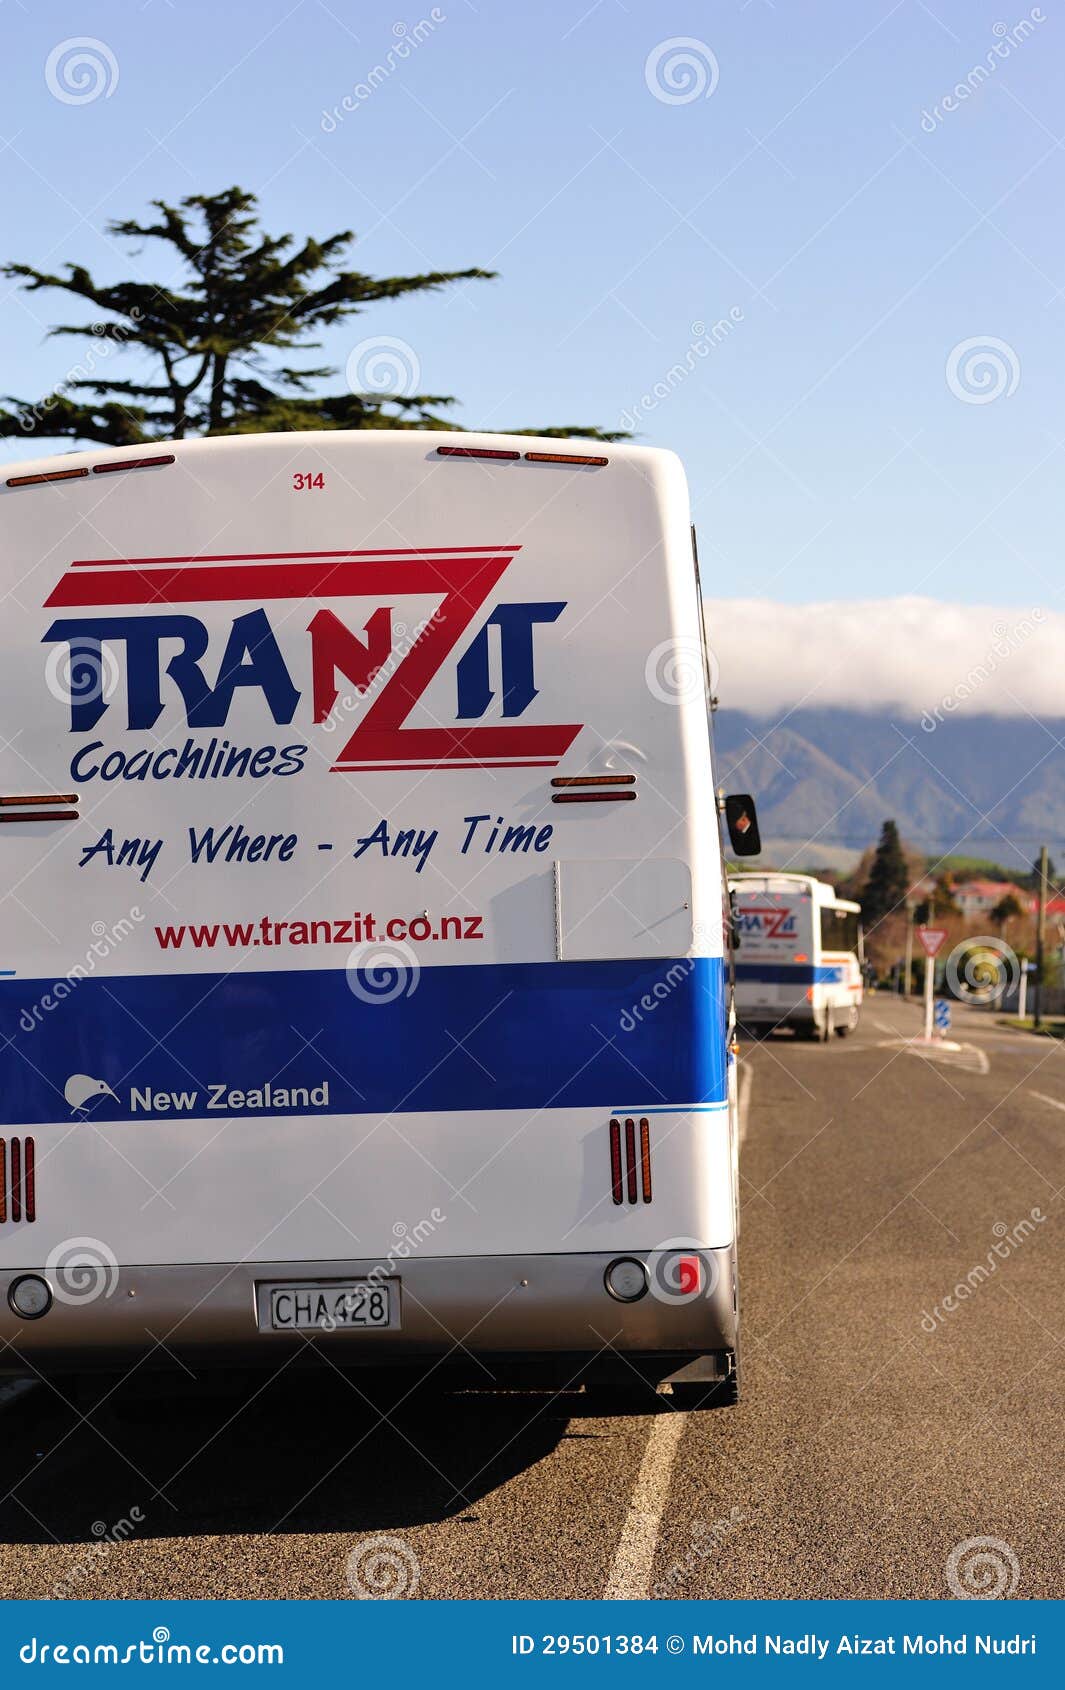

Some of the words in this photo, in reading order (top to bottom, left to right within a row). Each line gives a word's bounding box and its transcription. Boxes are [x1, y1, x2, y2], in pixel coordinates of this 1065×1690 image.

[293, 473, 325, 491] 314
[42, 556, 583, 762] TRANZIT
[70, 739, 308, 783] Coachlines
[79, 828, 163, 882] Any
[189, 825, 298, 864] Where
[353, 819, 439, 873] Any
[461, 815, 553, 853] Time
[155, 910, 484, 950] www.tranzit.co.nz
[130, 1087, 198, 1112] New
[206, 1081, 329, 1109] Zealand
[275, 1291, 385, 1324] CHA428
